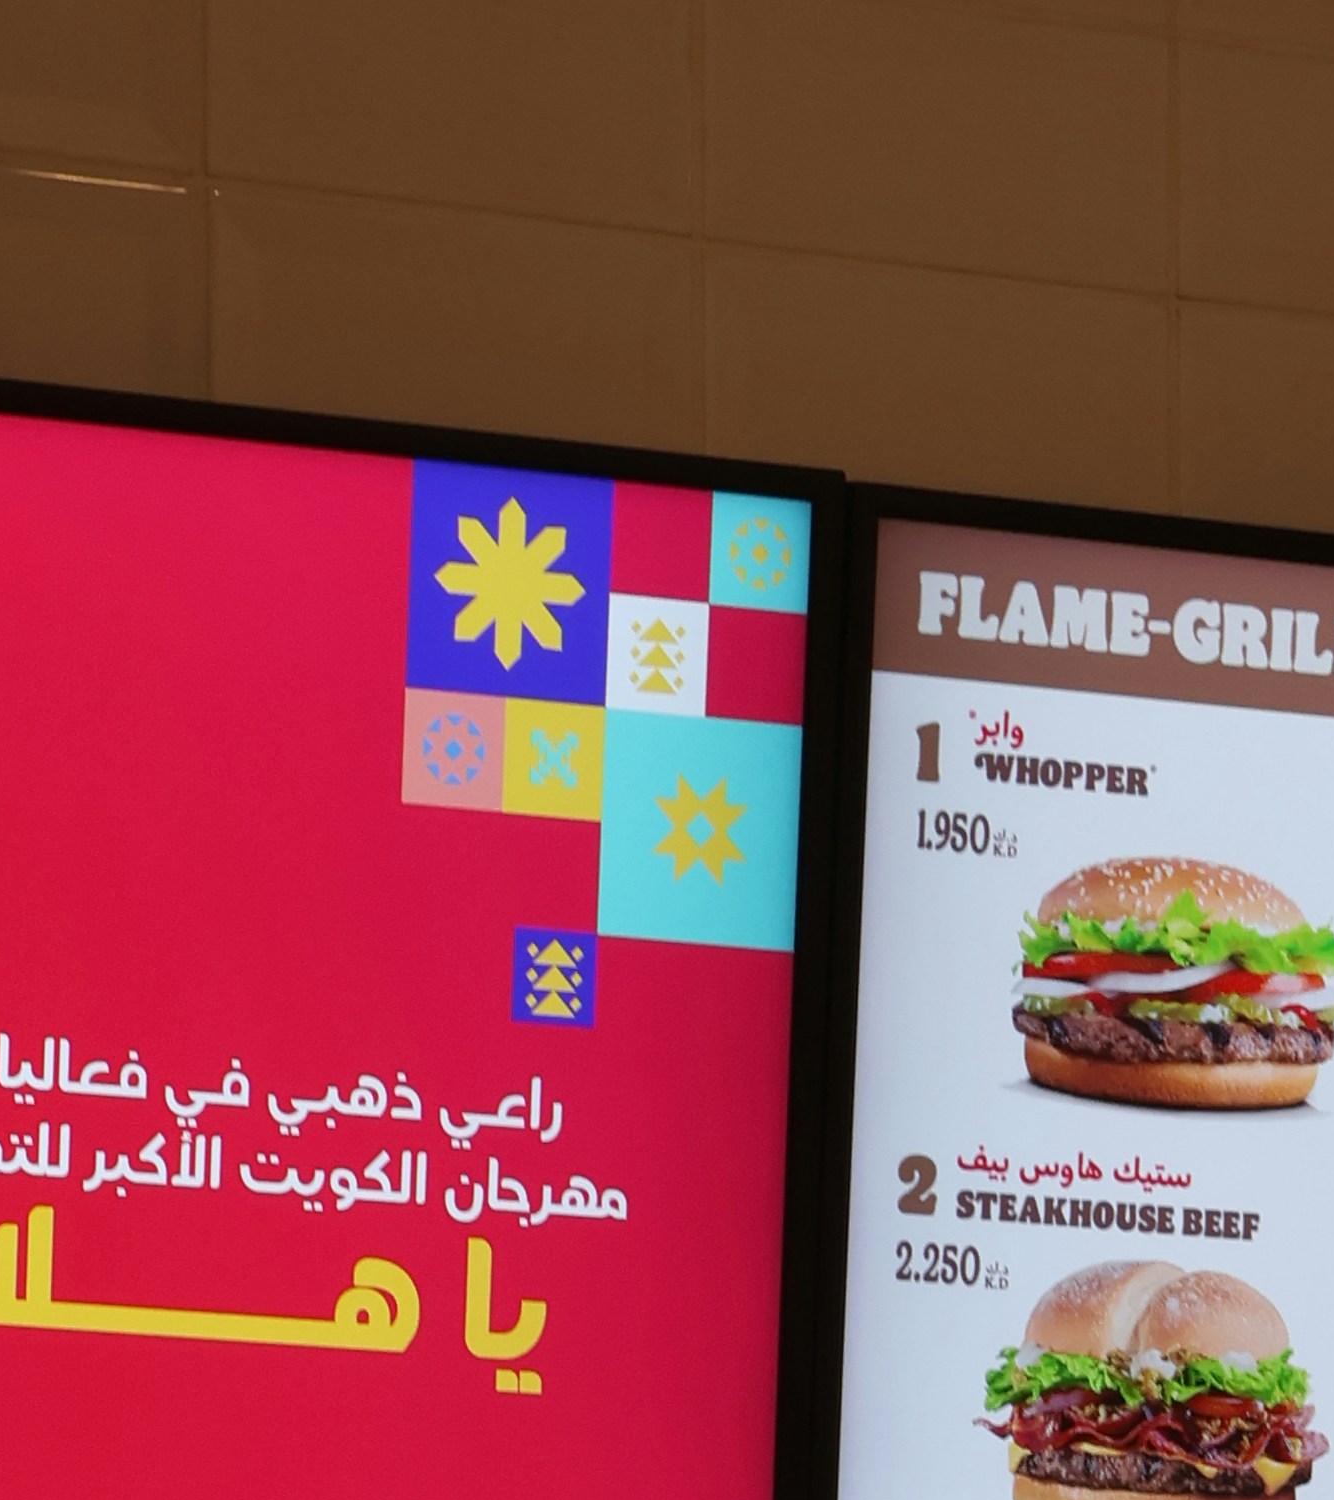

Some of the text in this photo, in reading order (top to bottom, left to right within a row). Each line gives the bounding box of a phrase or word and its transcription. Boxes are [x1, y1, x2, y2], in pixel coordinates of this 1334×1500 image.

[916, 722, 941, 783] 1
[974, 753, 1150, 797] WHOPPER
[918, 807, 990, 855] 1.950
[164, 1058, 251, 1128] في
[268, 1071, 423, 1138] ذهبي
[439, 1076, 564, 1152] راعي
[81, 1130, 224, 1199] الأكبر
[238, 1150, 427, 1213] الكويت
[444, 1157, 629, 1228] مهرجان
[897, 1152, 938, 1216] 2
[956, 1144, 1192, 1193] ستيك هاوس بيف
[955, 1189, 1260, 1241] STEAKHOUSE BEEF
[895, 1239, 982, 1287] 2.250
[464, 1236, 548, 1396] يا
